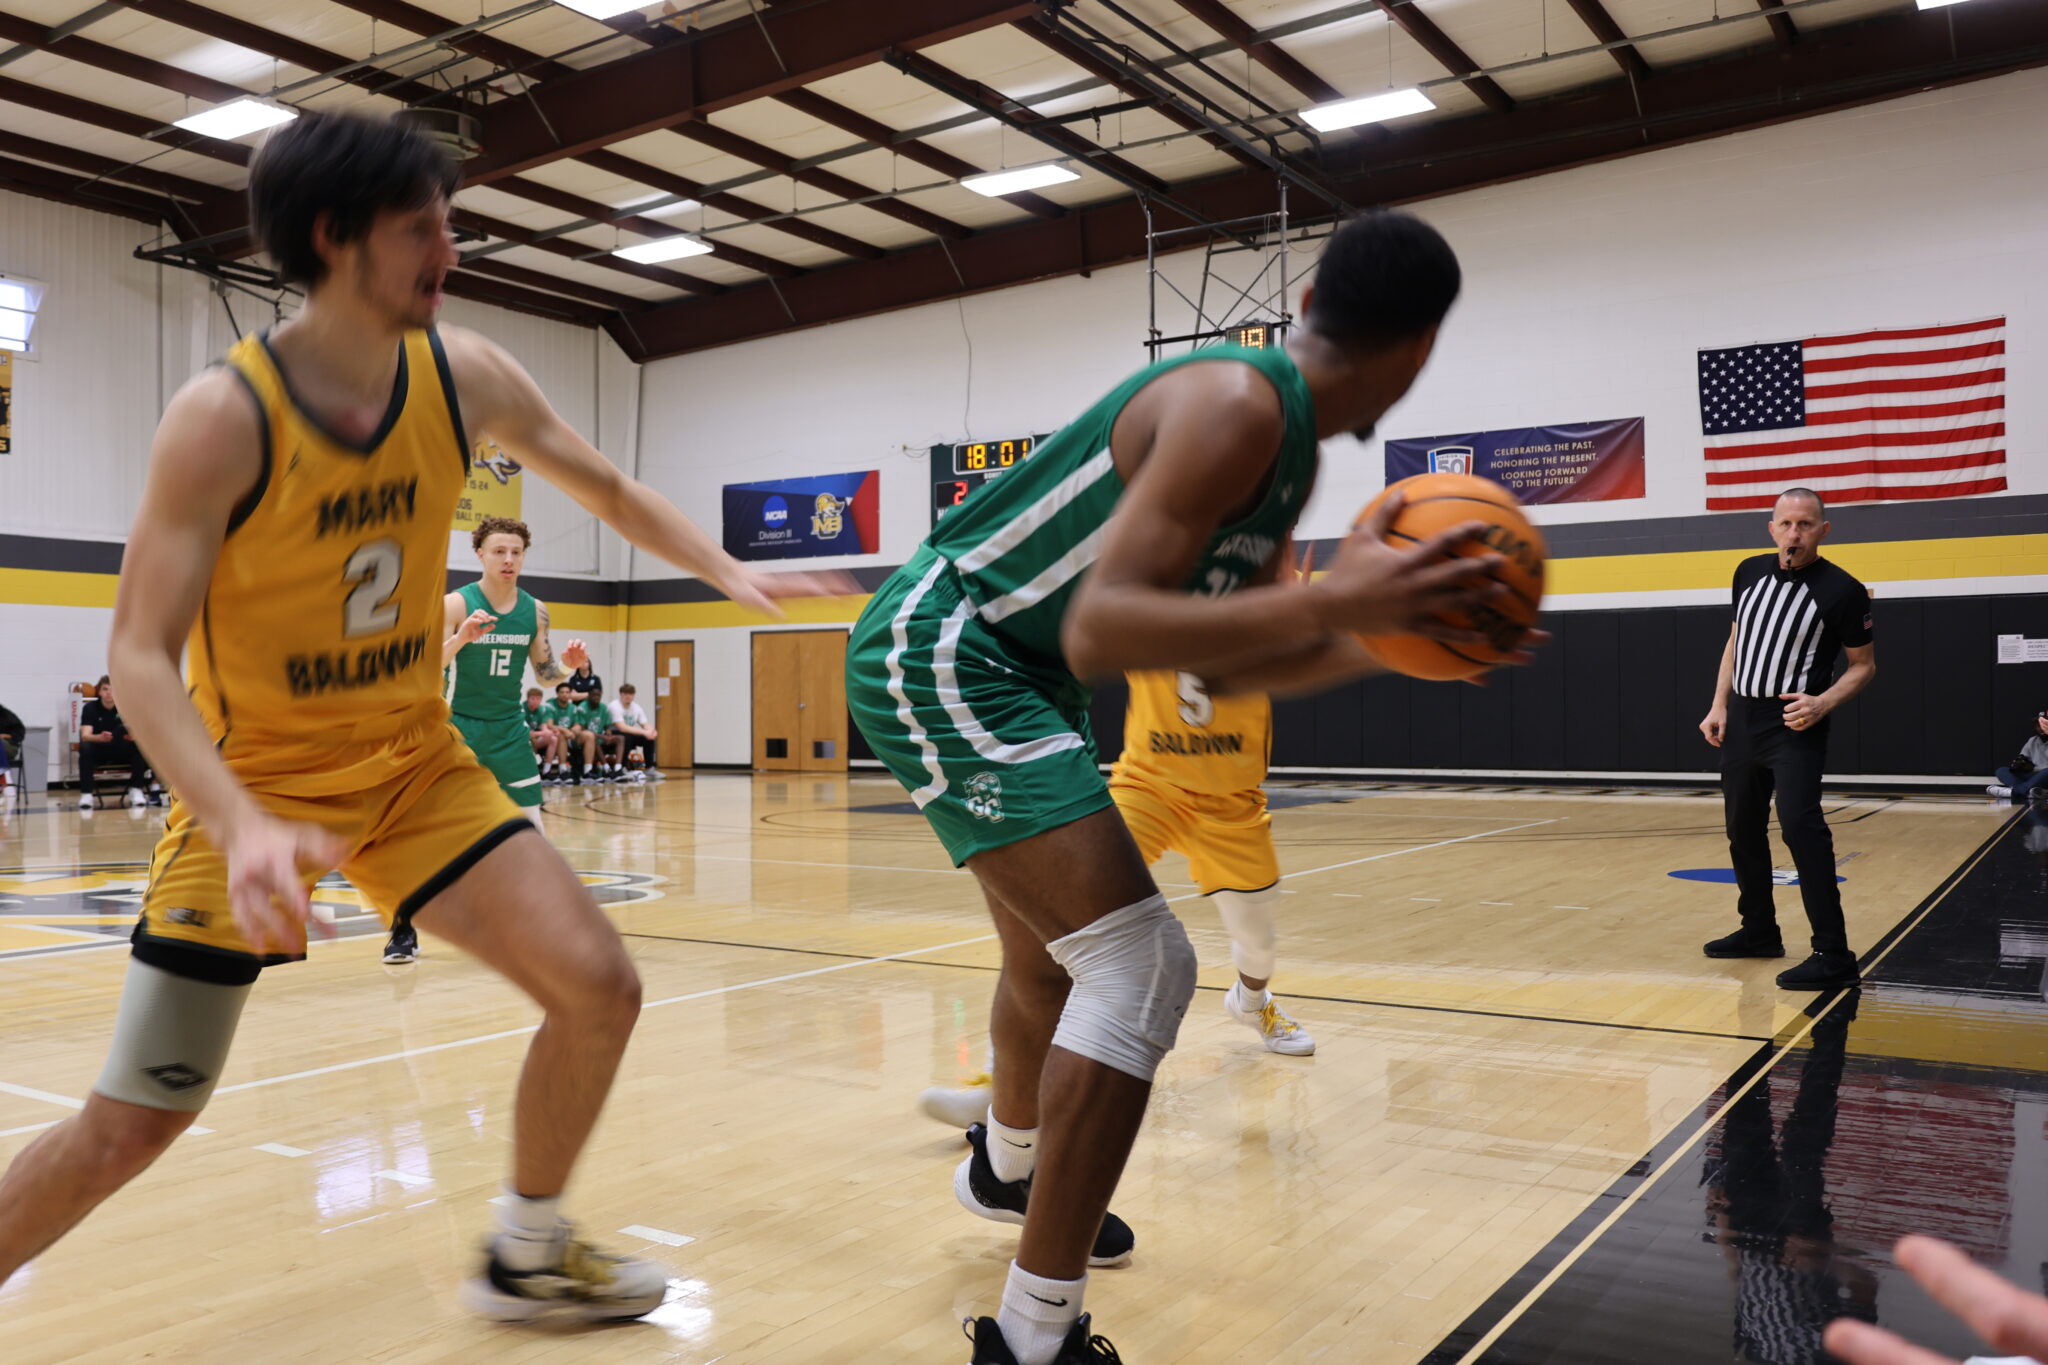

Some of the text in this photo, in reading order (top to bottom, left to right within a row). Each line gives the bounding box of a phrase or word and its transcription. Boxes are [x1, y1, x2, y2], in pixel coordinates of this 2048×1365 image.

[1241, 328, 1264, 350] 19
[966, 440, 1028, 470] 18:01
[1494, 441, 1595, 457] CELEBRATING THE PAST.
[1437, 459, 1465, 473] 50
[1490, 453, 1600, 469] HONORING THE PRESENT.
[1501, 466, 1588, 480] LOOKING FORWARD
[1512, 476, 1577, 488] TO THE FUTURE.
[953, 480, 969, 506] 2
[314, 474, 418, 542] MARY
[764, 510, 788, 522] NCAA
[758, 529, 786, 541] Division
[810, 516, 843, 535] MB
[341, 535, 404, 641] 2
[489, 649, 513, 677] 12
[1176, 671, 1215, 729] 5
[1148, 730, 1244, 756] BALDWIN
